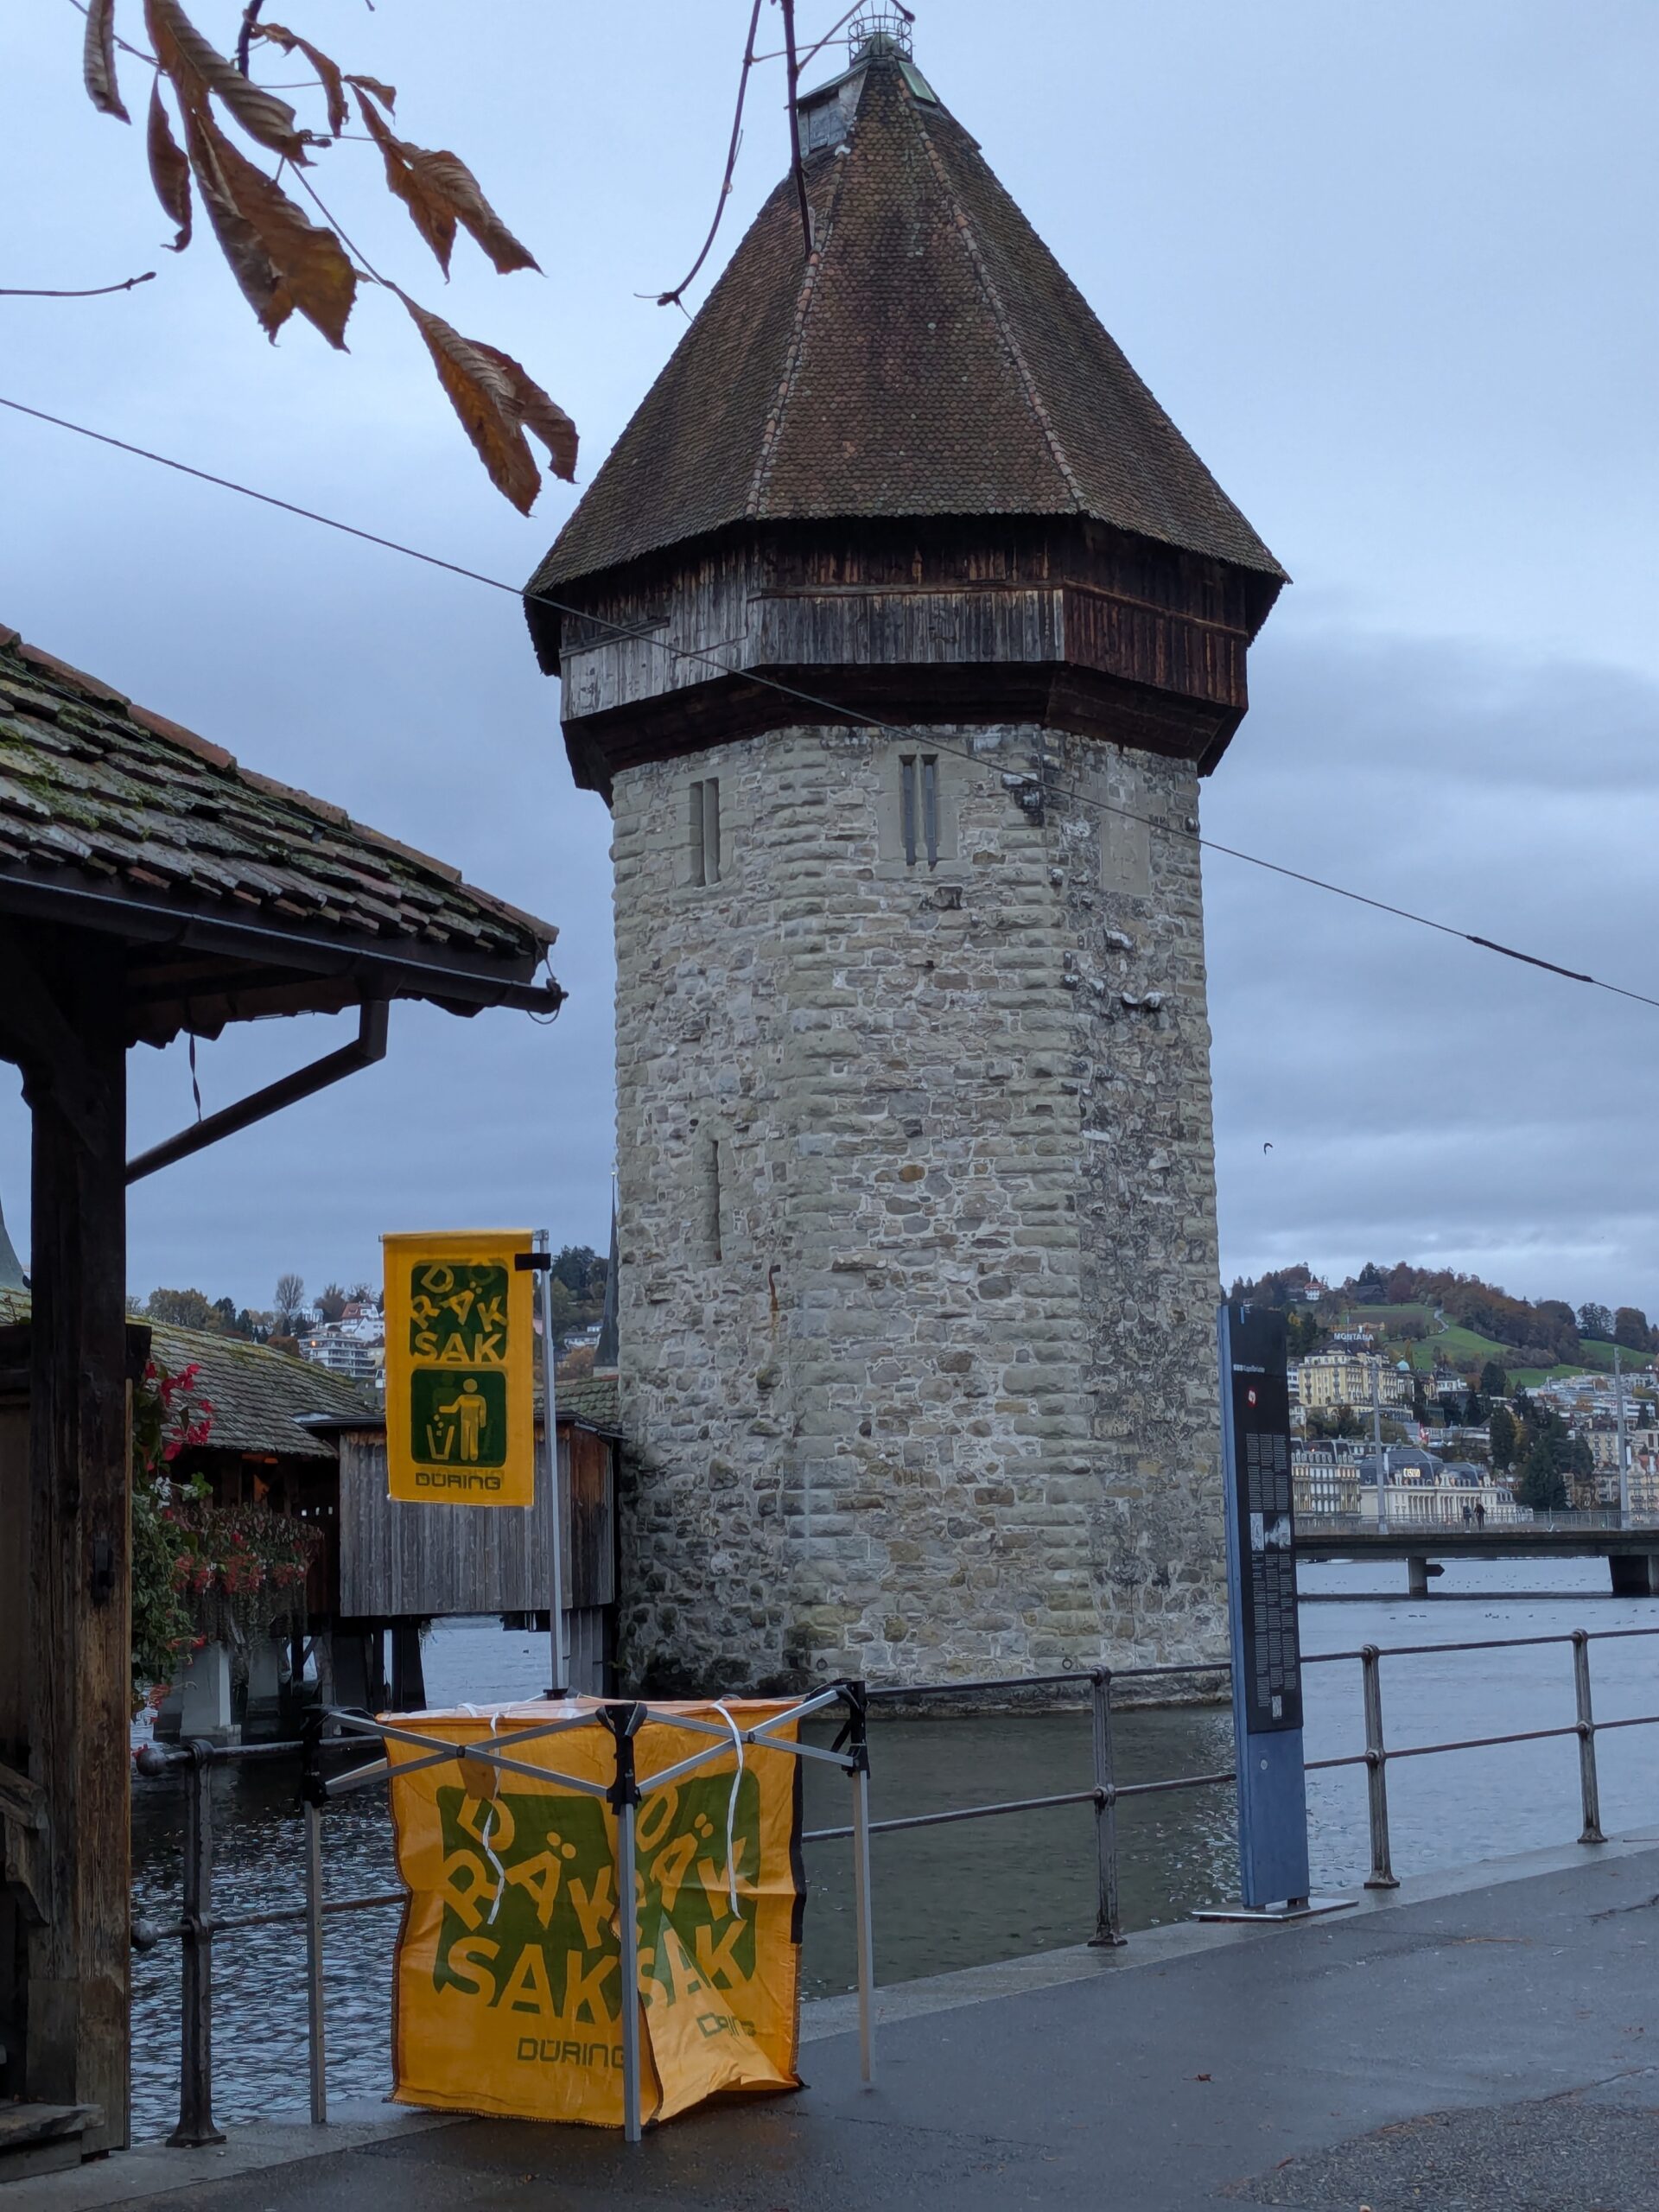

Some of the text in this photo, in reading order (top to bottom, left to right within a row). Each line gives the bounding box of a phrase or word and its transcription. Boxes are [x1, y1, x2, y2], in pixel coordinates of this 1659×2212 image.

[413, 1331, 506, 1363] SAK
[1333, 1332, 1375, 1342] MONTANA
[416, 1471, 501, 1491] DÜRING
